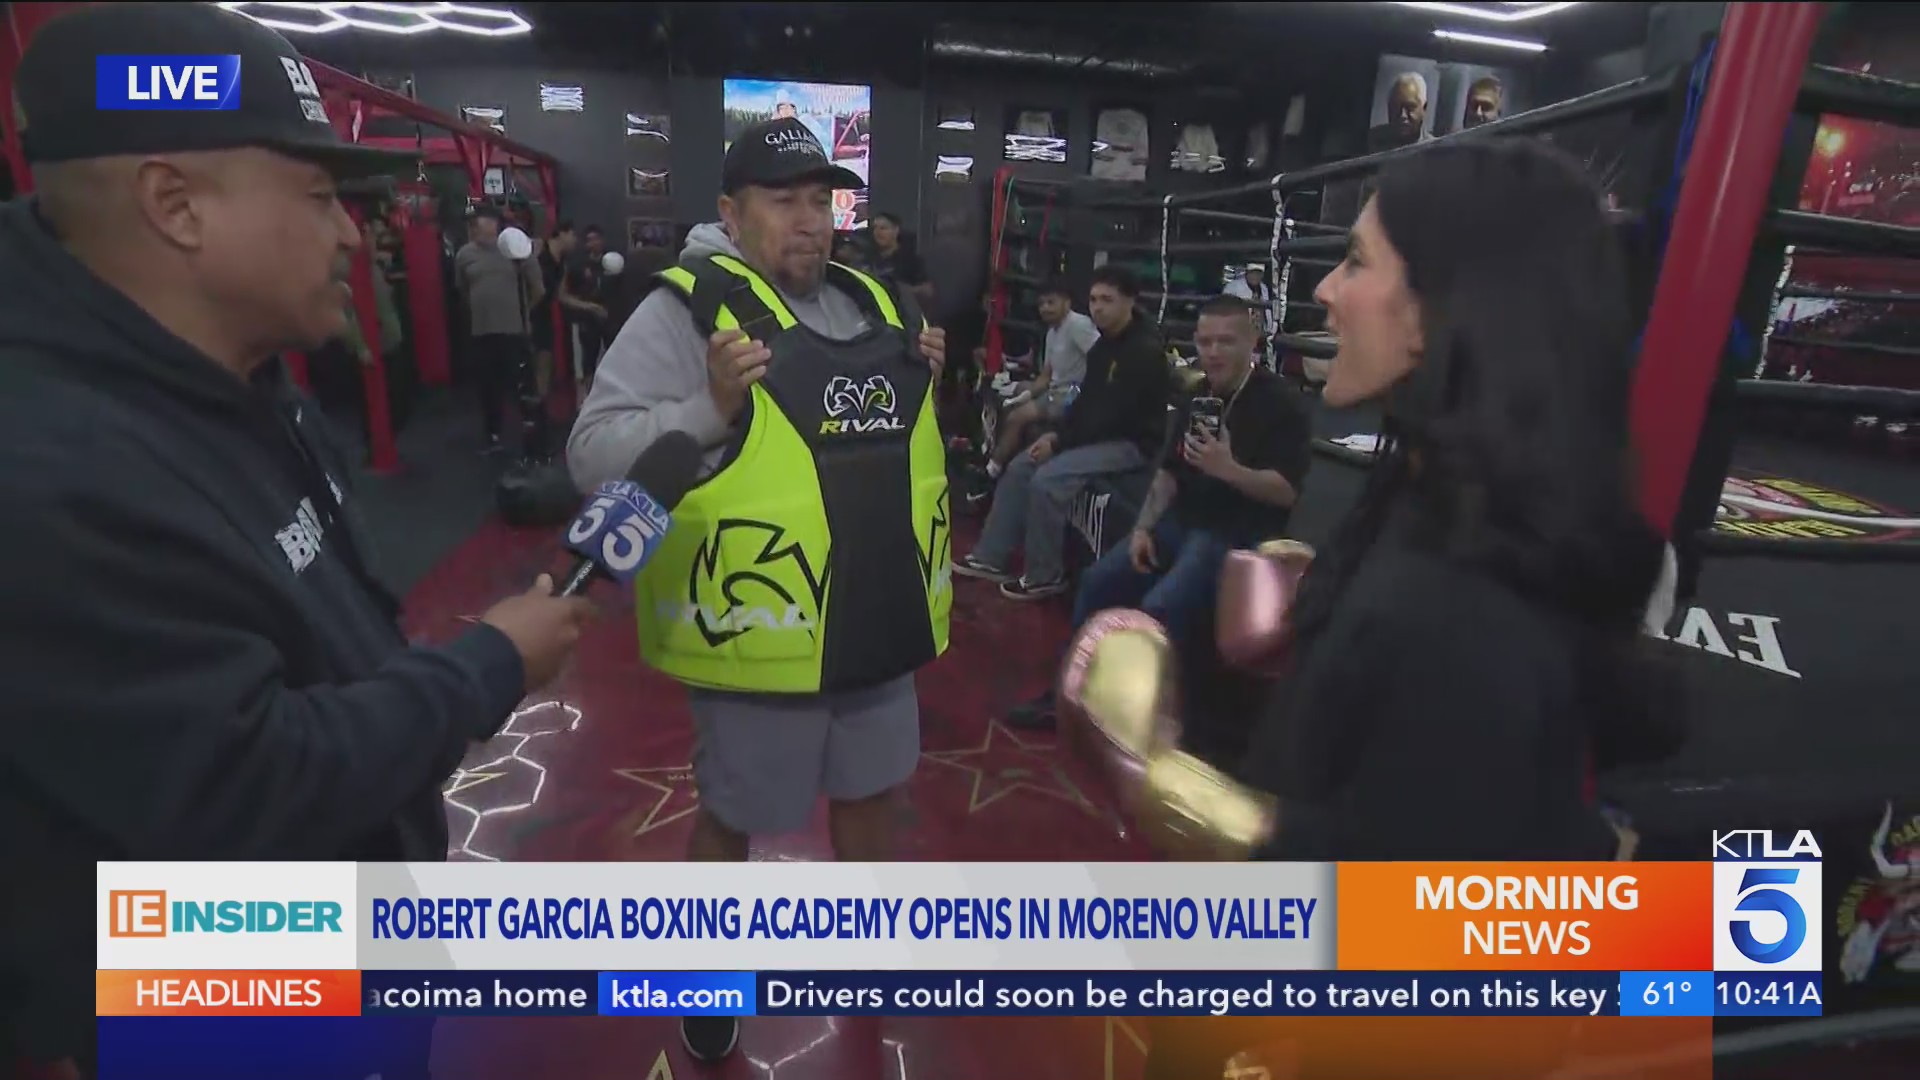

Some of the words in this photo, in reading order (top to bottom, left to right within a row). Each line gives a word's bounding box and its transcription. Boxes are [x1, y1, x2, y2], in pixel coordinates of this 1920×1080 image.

[819, 417, 906, 434] RIVAL
[568, 497, 616, 544] 5
[602, 513, 655, 571] 5
[1652, 606, 1803, 679] EV
